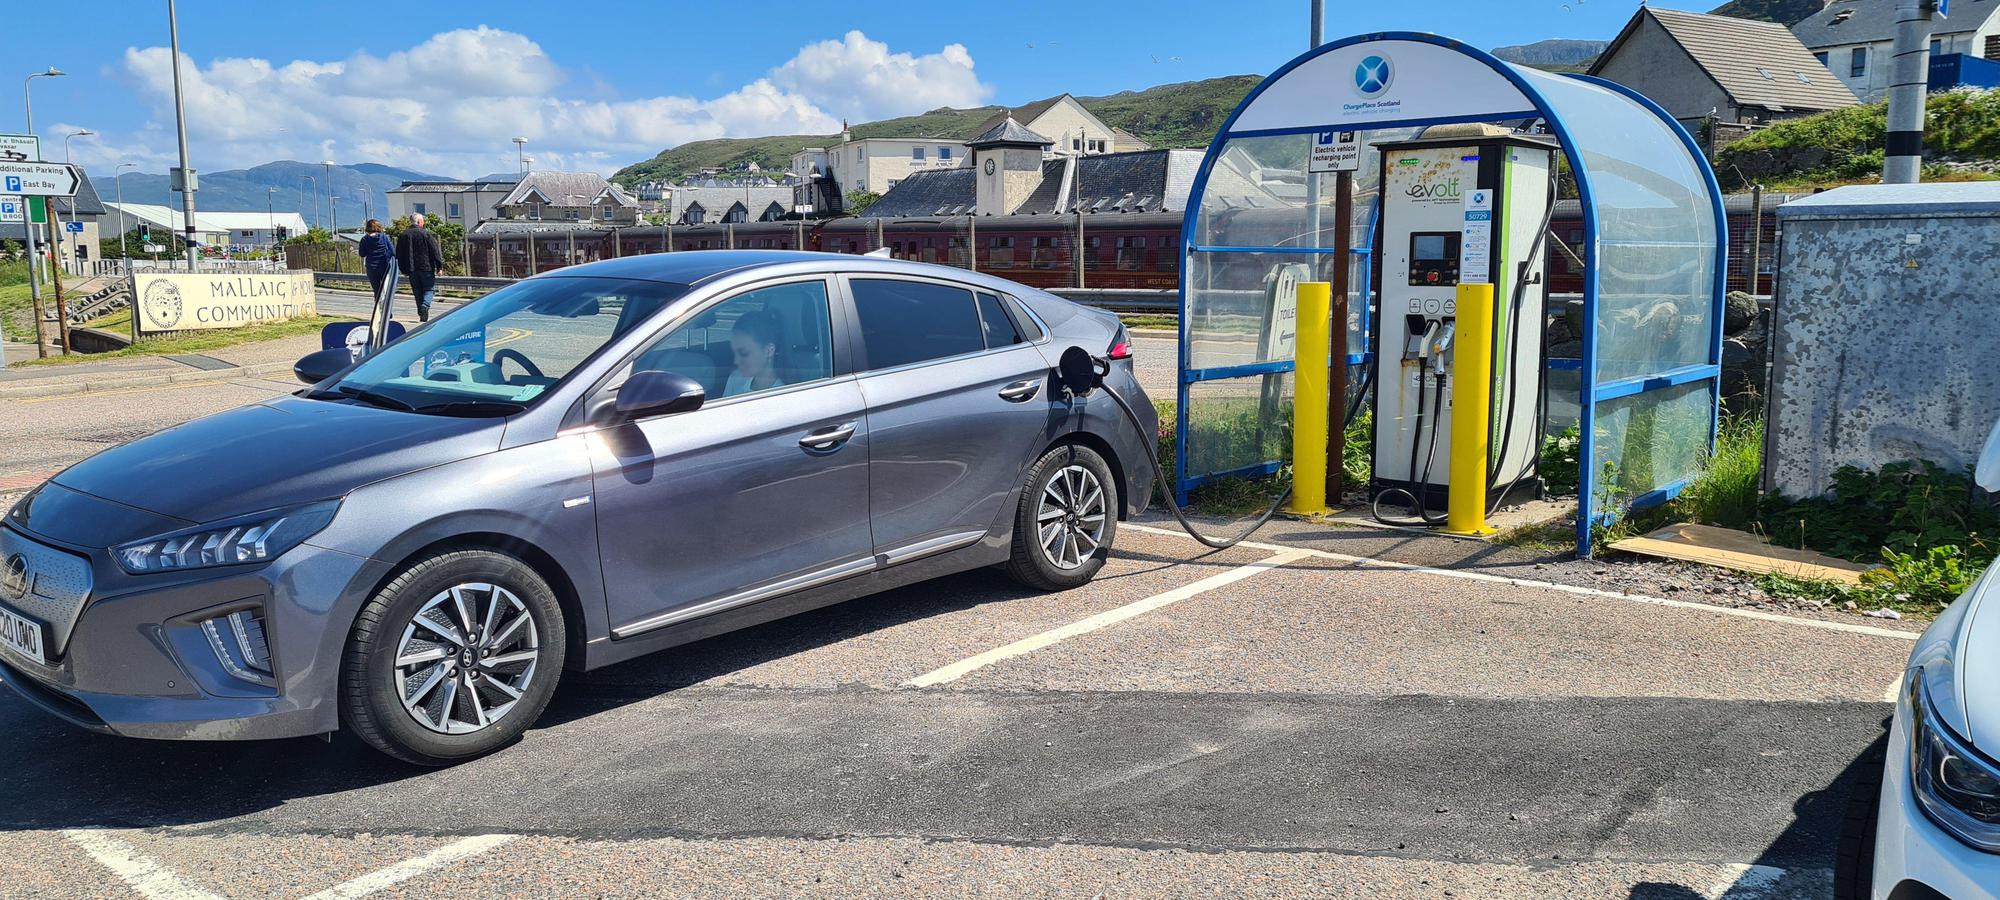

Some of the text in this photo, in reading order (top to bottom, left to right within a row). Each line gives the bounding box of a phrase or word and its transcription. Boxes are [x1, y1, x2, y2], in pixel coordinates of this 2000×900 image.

[1343, 102, 1376, 110] ChargePlace
[1315, 145, 1335, 153] Electric
[0, 165, 64, 175] dditional Parking
[1328, 161, 1339, 169] only
[9, 178, 19, 190] P
[42, 181, 55, 189] Bay
[4, 204, 12, 212] P
[210, 278, 286, 301] MALLAIG
[1280, 308, 1296, 320] TOILE
[456, 331, 482, 341] NTURE
[0, 612, 36, 654] 20 UNO
